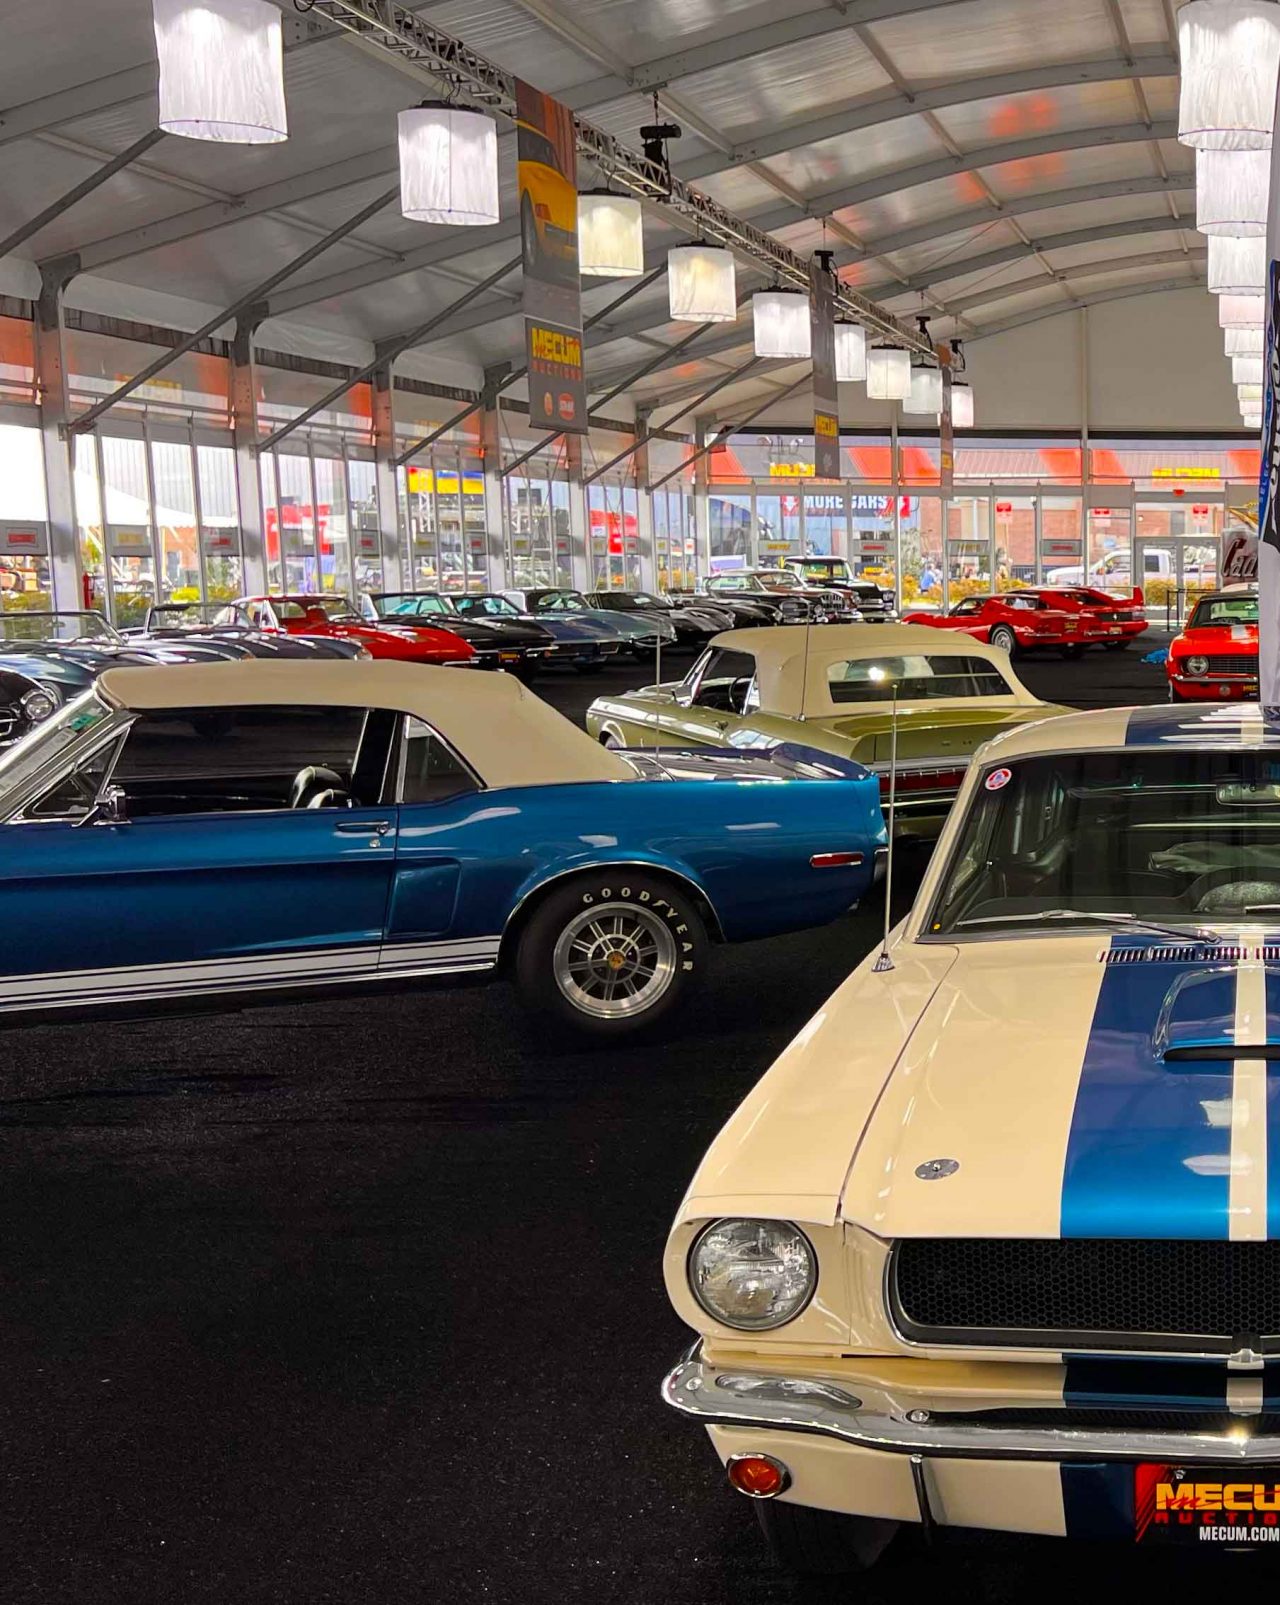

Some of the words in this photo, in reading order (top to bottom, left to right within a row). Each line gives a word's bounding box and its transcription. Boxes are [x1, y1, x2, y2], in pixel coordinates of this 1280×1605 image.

[531, 327, 581, 368] MECUM
[582, 886, 694, 972] GOODYEAR
[1199, 1526, 1280, 1542] MECUM.COM
